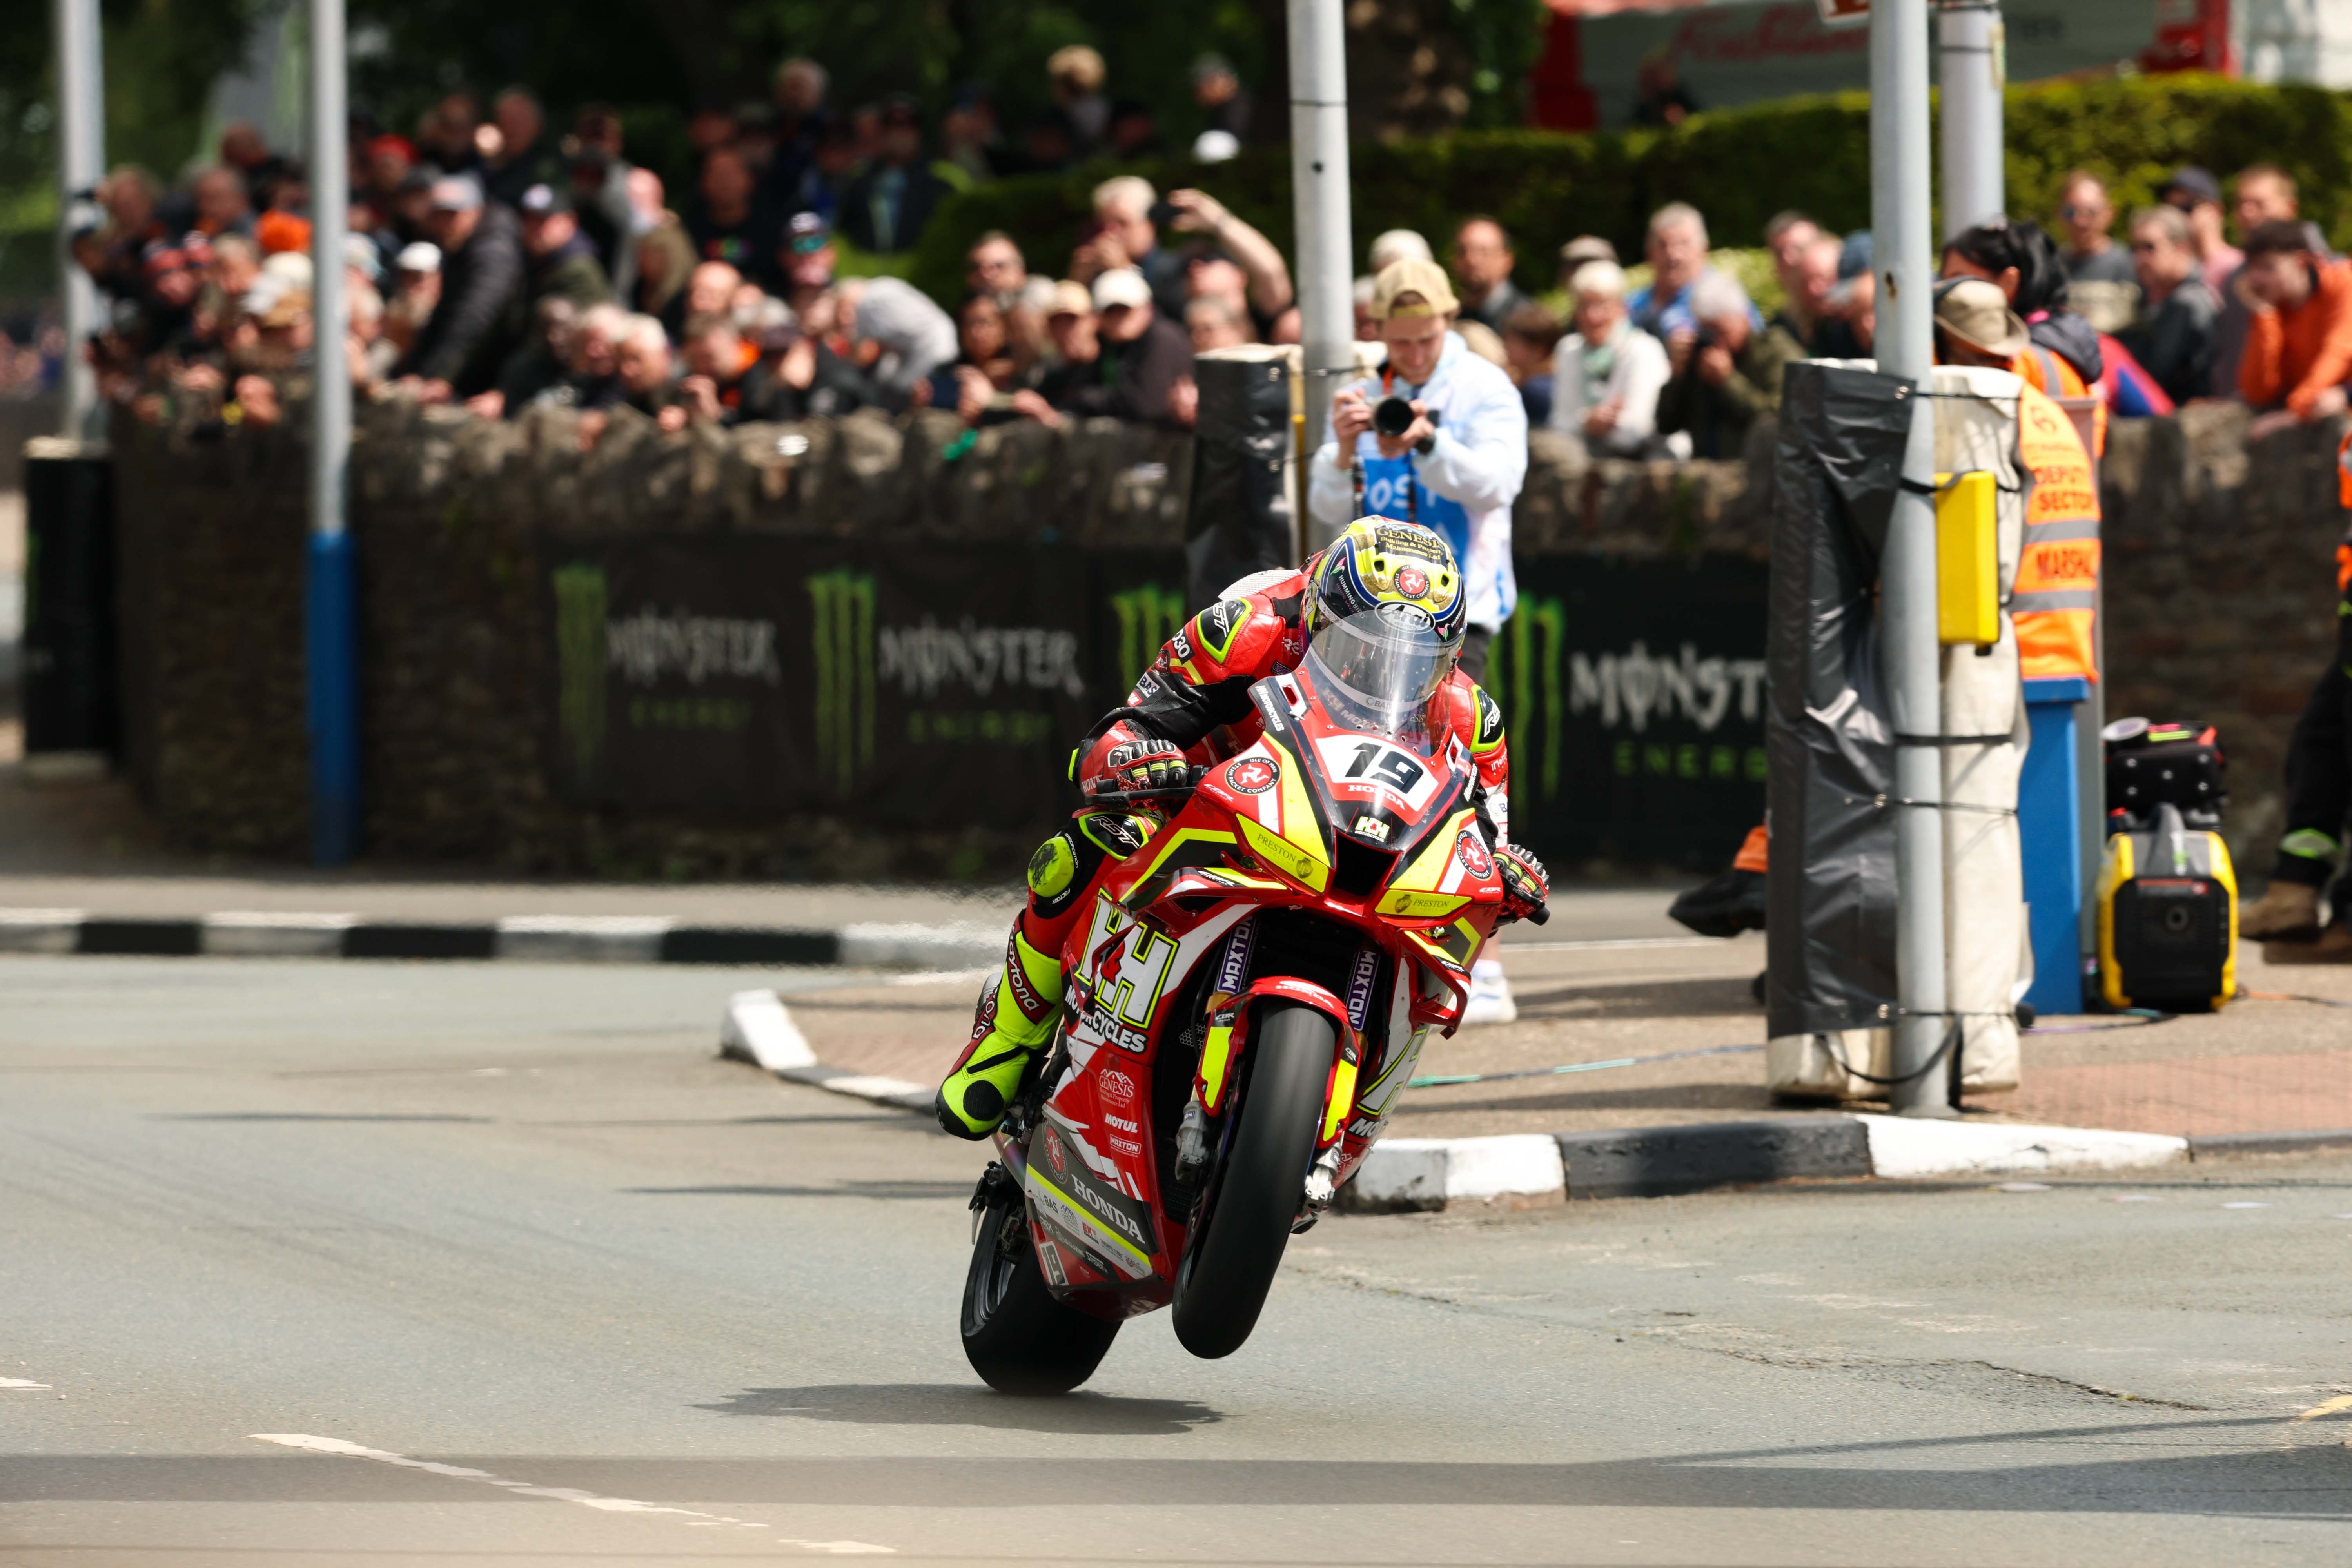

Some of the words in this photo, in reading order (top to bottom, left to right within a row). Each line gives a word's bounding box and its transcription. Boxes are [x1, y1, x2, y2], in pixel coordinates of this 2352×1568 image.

[1376, 528, 1439, 548] GENESI
[1338, 575, 1365, 619] HUMMINGBIRD
[1398, 588, 1415, 598] PACKET
[1416, 580, 1430, 598] COMPANY
[1381, 604, 1430, 627] Arai
[1139, 675, 1157, 695] BAS
[1228, 762, 1242, 776] STEAM
[1269, 762, 1278, 773] MAN
[1345, 742, 1424, 794] 19
[1228, 777, 1246, 791] PACKET
[1247, 778, 1276, 793] COMPANY
[1089, 816, 1140, 849] RST
[1354, 830, 1385, 843] MOTORCYCLES
[1355, 816, 1390, 839] H&H
[1457, 831, 1468, 844] STEAM
[1064, 833, 1079, 869] SPECIFICATION
[1257, 833, 1296, 862] PRESTON
[1457, 843, 1468, 866] PACKET
[1468, 867, 1490, 878] COMPANY
[1052, 887, 1071, 905] FACTORY
[1413, 899, 1449, 908] PRESTON
[1348, 951, 1376, 1025] MAXTON
[1065, 984, 1147, 1054] MOCYCLES
[1099, 1075, 1134, 1098] GENESIS
[1112, 1093, 1130, 1104] Property
[1105, 1112, 1138, 1134] MOTUL
[1111, 1137, 1138, 1152] MAXTON
[1044, 1194, 1058, 1214] BAS
[1071, 1173, 1145, 1244] HONDA
